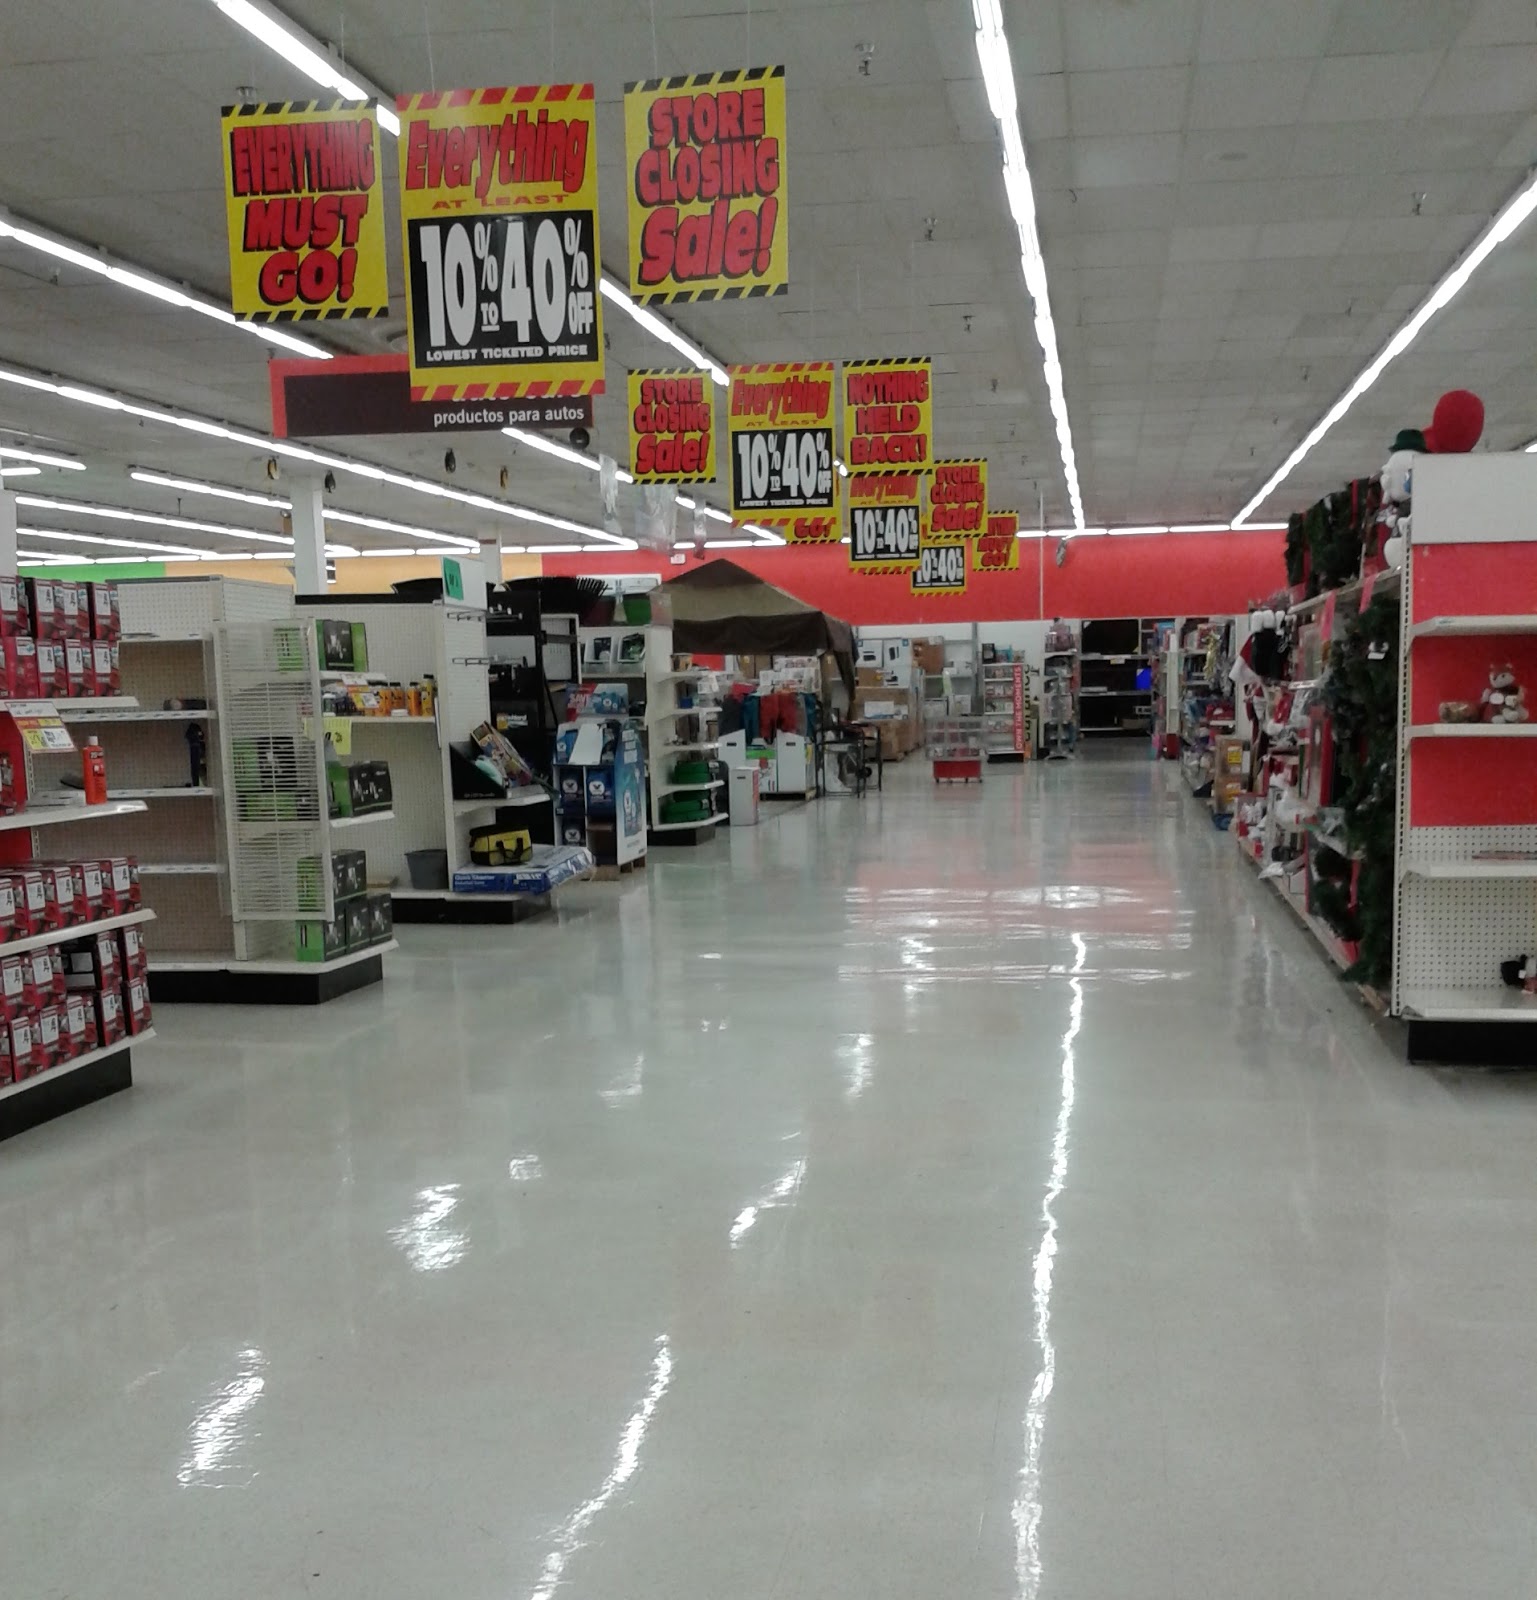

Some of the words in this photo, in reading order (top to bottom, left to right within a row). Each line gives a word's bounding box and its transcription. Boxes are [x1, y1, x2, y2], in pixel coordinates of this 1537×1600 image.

[648, 88, 765, 148] STORE
[230, 118, 375, 197] EVERYTHING
[406, 109, 589, 199] Everything
[635, 137, 779, 207] CLOSING
[432, 199, 467, 210] AT
[480, 194, 568, 208] LEAST
[243, 194, 369, 252] MUST
[638, 196, 778, 286] Sale!
[259, 247, 358, 305] GO!
[480, 302, 500, 332] TO
[568, 291, 594, 335] OFF
[427, 349, 477, 361] LOWEST
[482, 346, 543, 359] TICKETED
[548, 345, 588, 356] PRICE
[641, 378, 703, 404] STORE
[732, 375, 831, 423] Everything
[847, 369, 929, 406] NOTHING
[434, 409, 504, 427] productos
[509, 410, 540, 425] para
[545, 406, 585, 420] autos
[634, 403, 710, 434] CLOSING
[856, 404, 921, 435] HELD
[635, 431, 710, 474] Sale!
[850, 434, 927, 465] BACK!
[931, 482, 985, 504] CLOSING
[936, 465, 980, 485] STORE
[931, 502, 984, 532] Sale!
